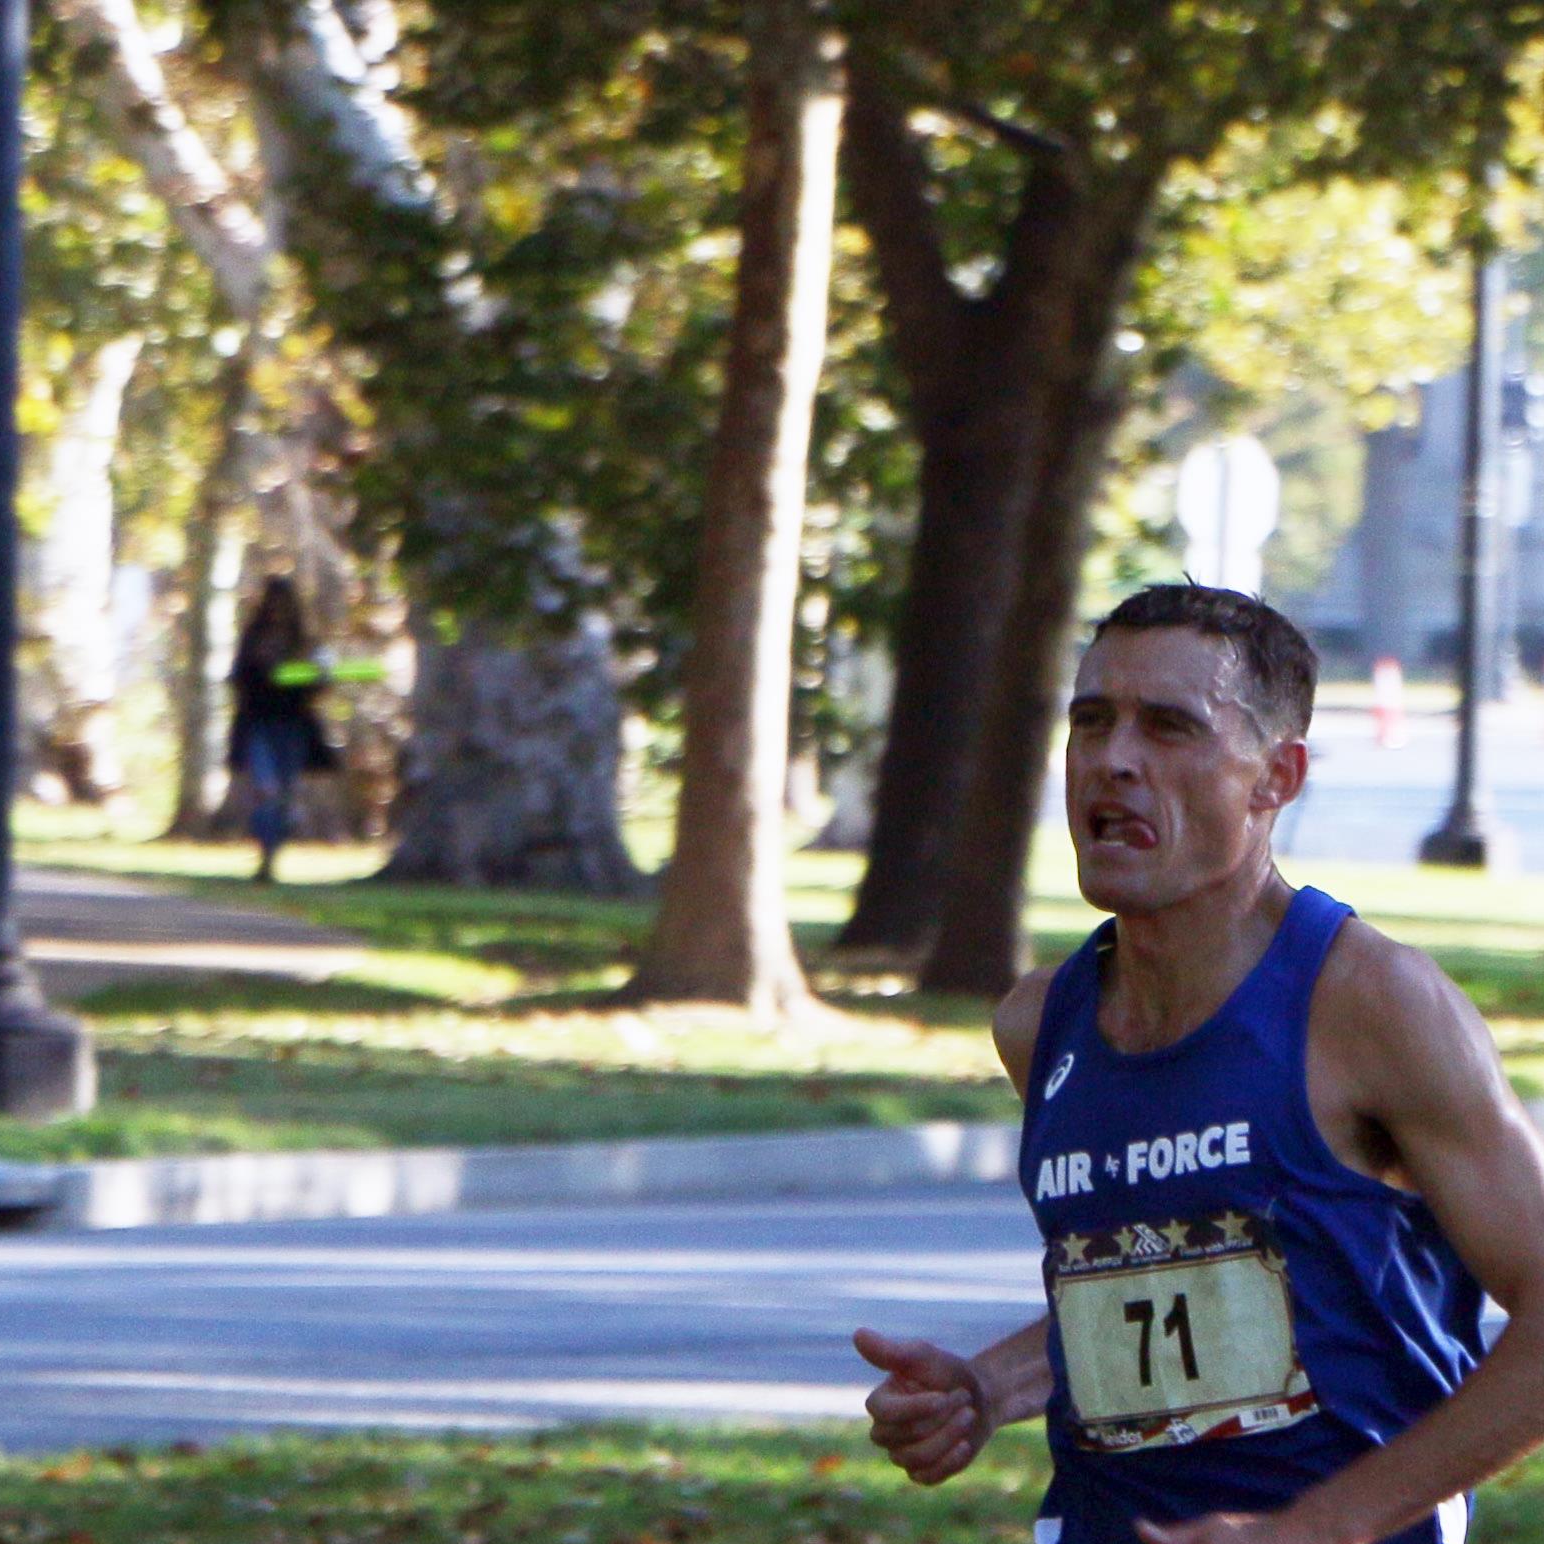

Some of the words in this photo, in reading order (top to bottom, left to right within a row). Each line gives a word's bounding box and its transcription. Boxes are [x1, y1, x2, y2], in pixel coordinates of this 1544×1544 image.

[1036, 1152, 1095, 1202] AIR
[1127, 1121, 1251, 1186] FORCE
[1123, 1293, 1200, 1387] 71
